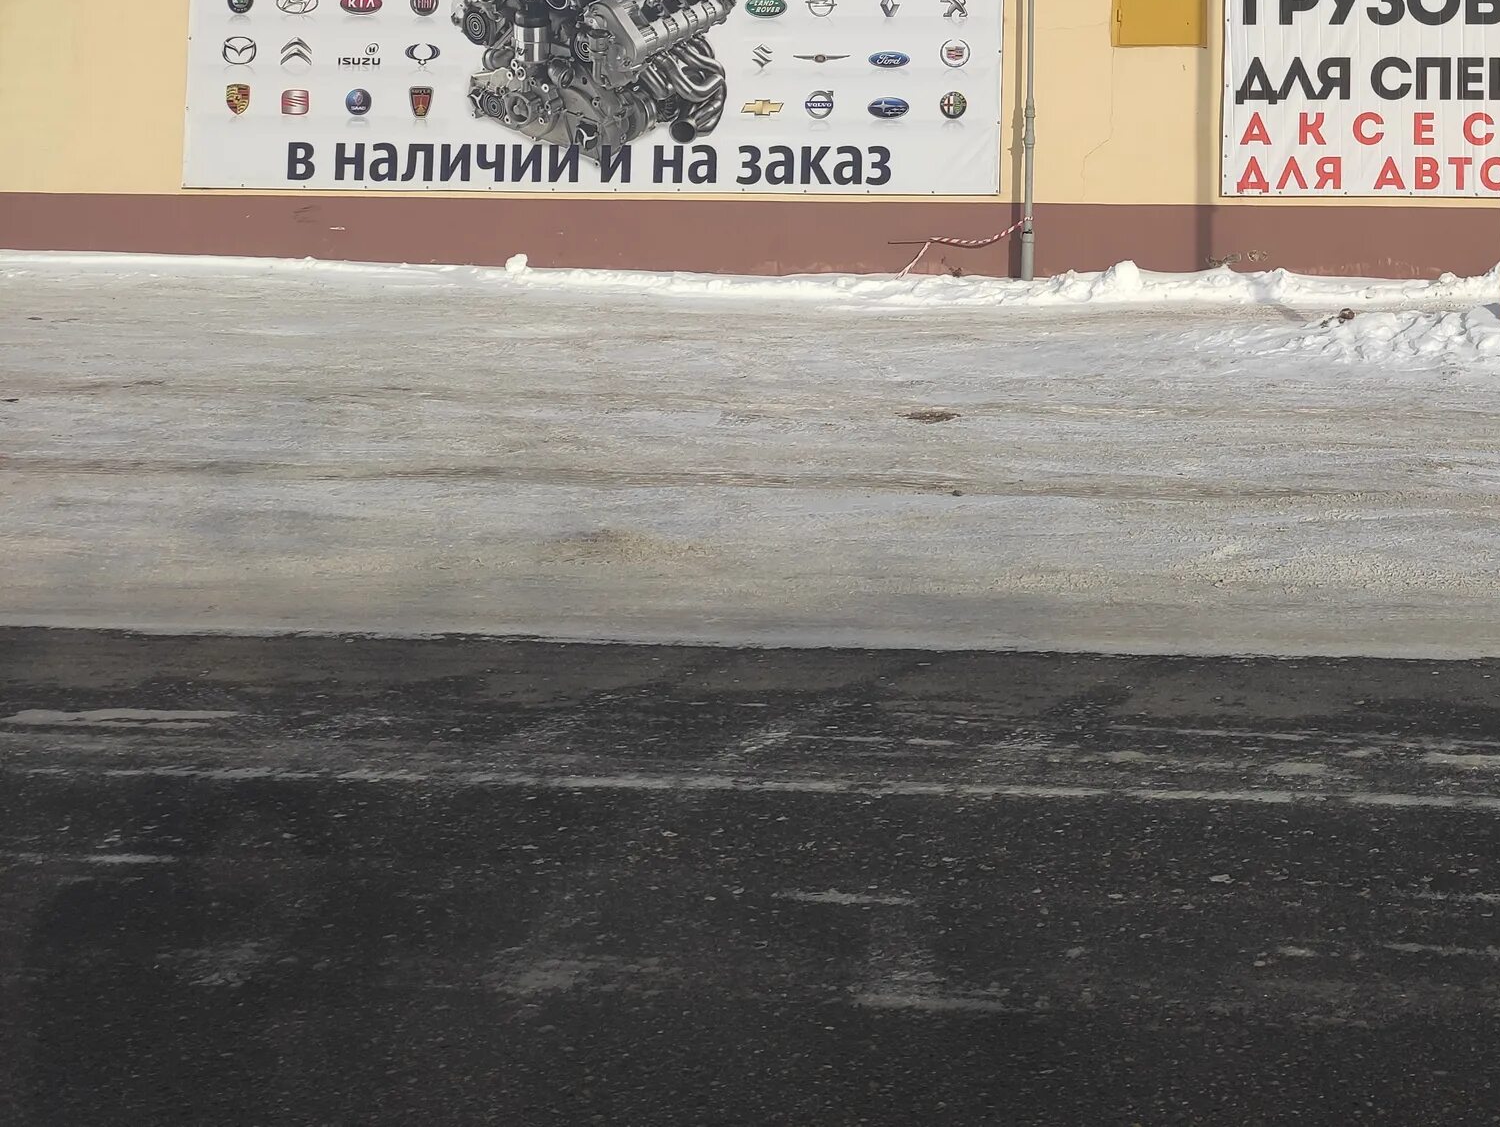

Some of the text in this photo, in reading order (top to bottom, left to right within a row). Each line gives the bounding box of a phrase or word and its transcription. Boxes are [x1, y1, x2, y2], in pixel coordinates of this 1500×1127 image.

[338, 57, 381, 66] ISUZU
[876, 55, 901, 66] Ford
[1235, 56, 1351, 105] ДЛЯ
[286, 141, 892, 186] в наличии и на заказ
[1236, 156, 1342, 193] ДЛЯ
